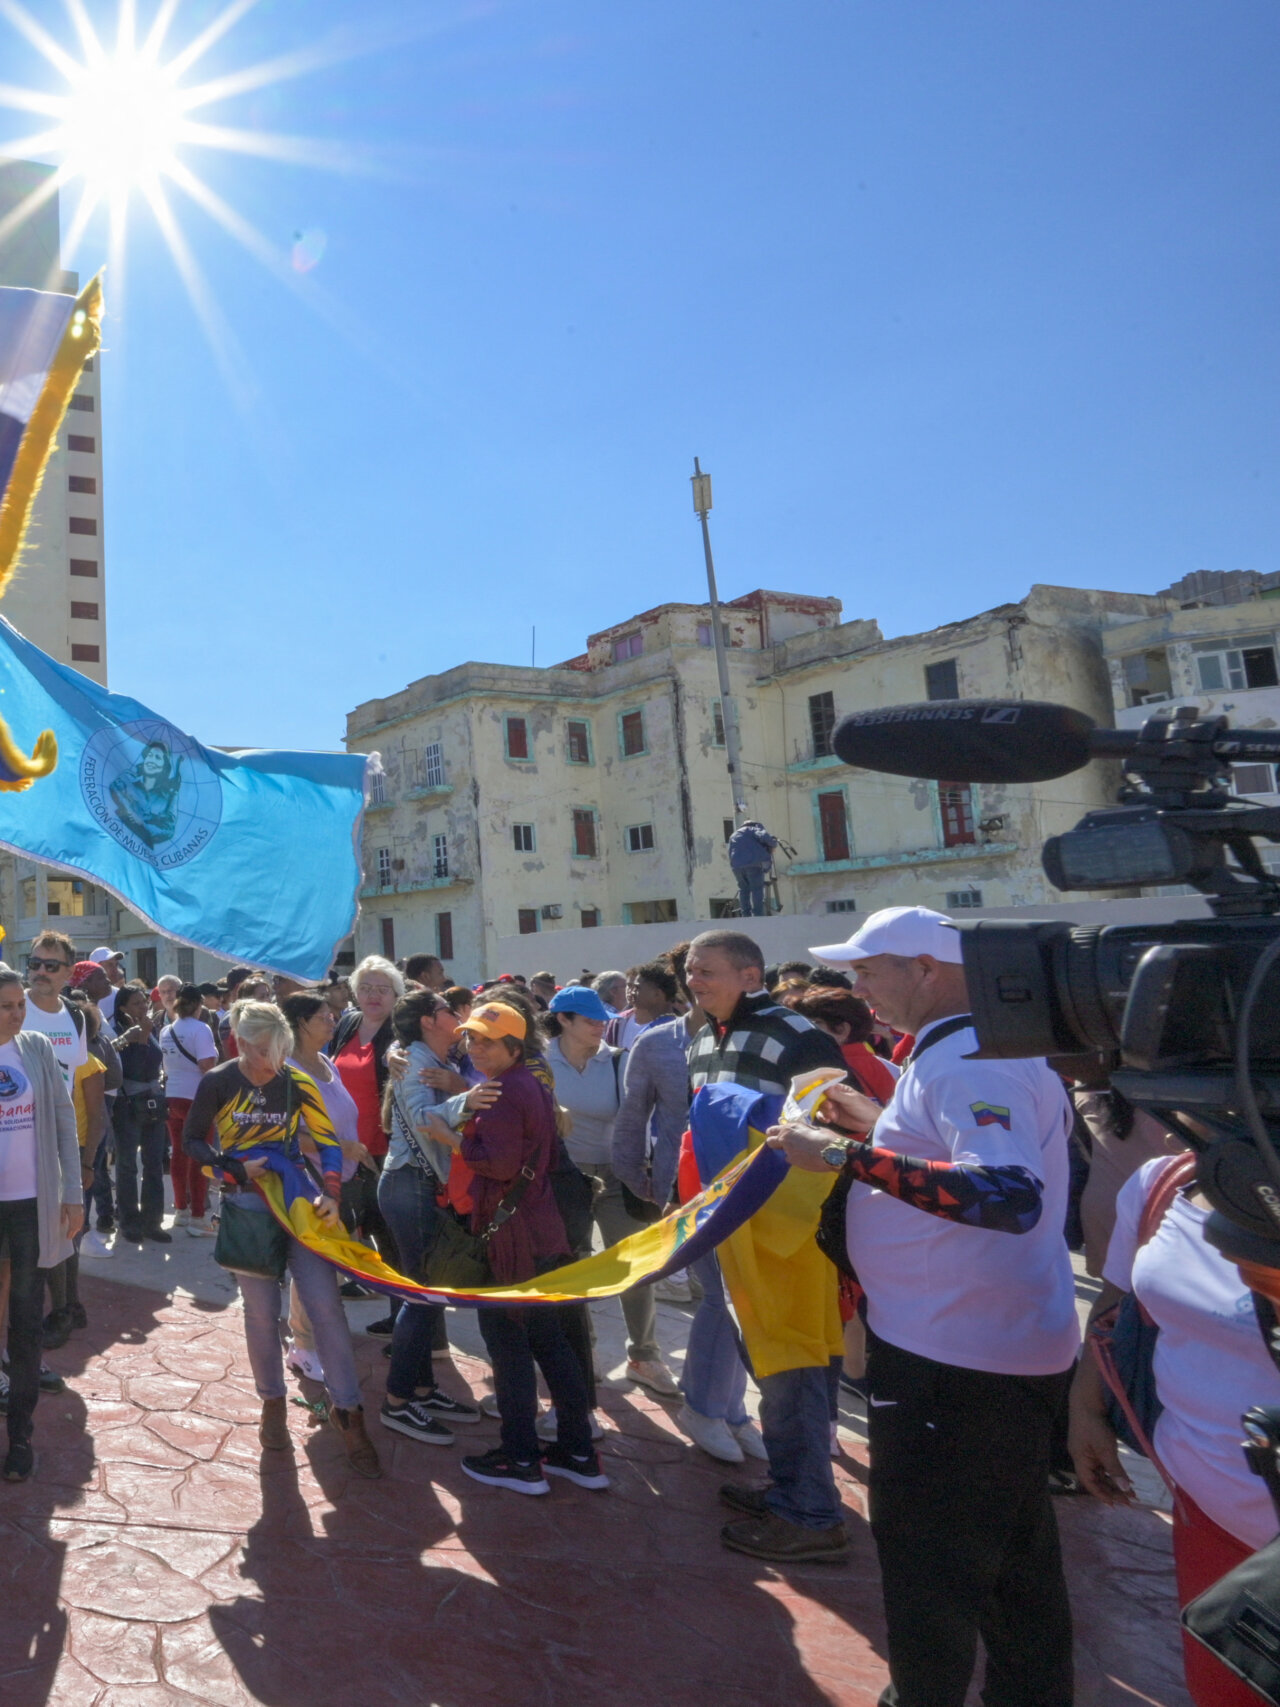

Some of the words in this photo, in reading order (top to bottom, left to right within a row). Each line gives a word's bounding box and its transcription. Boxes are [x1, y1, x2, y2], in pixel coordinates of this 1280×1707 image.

[854, 708, 975, 727] SENNHEISER
[1246, 743, 1280, 752] SEN
[84, 755, 111, 824] FEDERACIÓN
[109, 822, 123, 838] DE
[160, 827, 209, 866] CUBANAS
